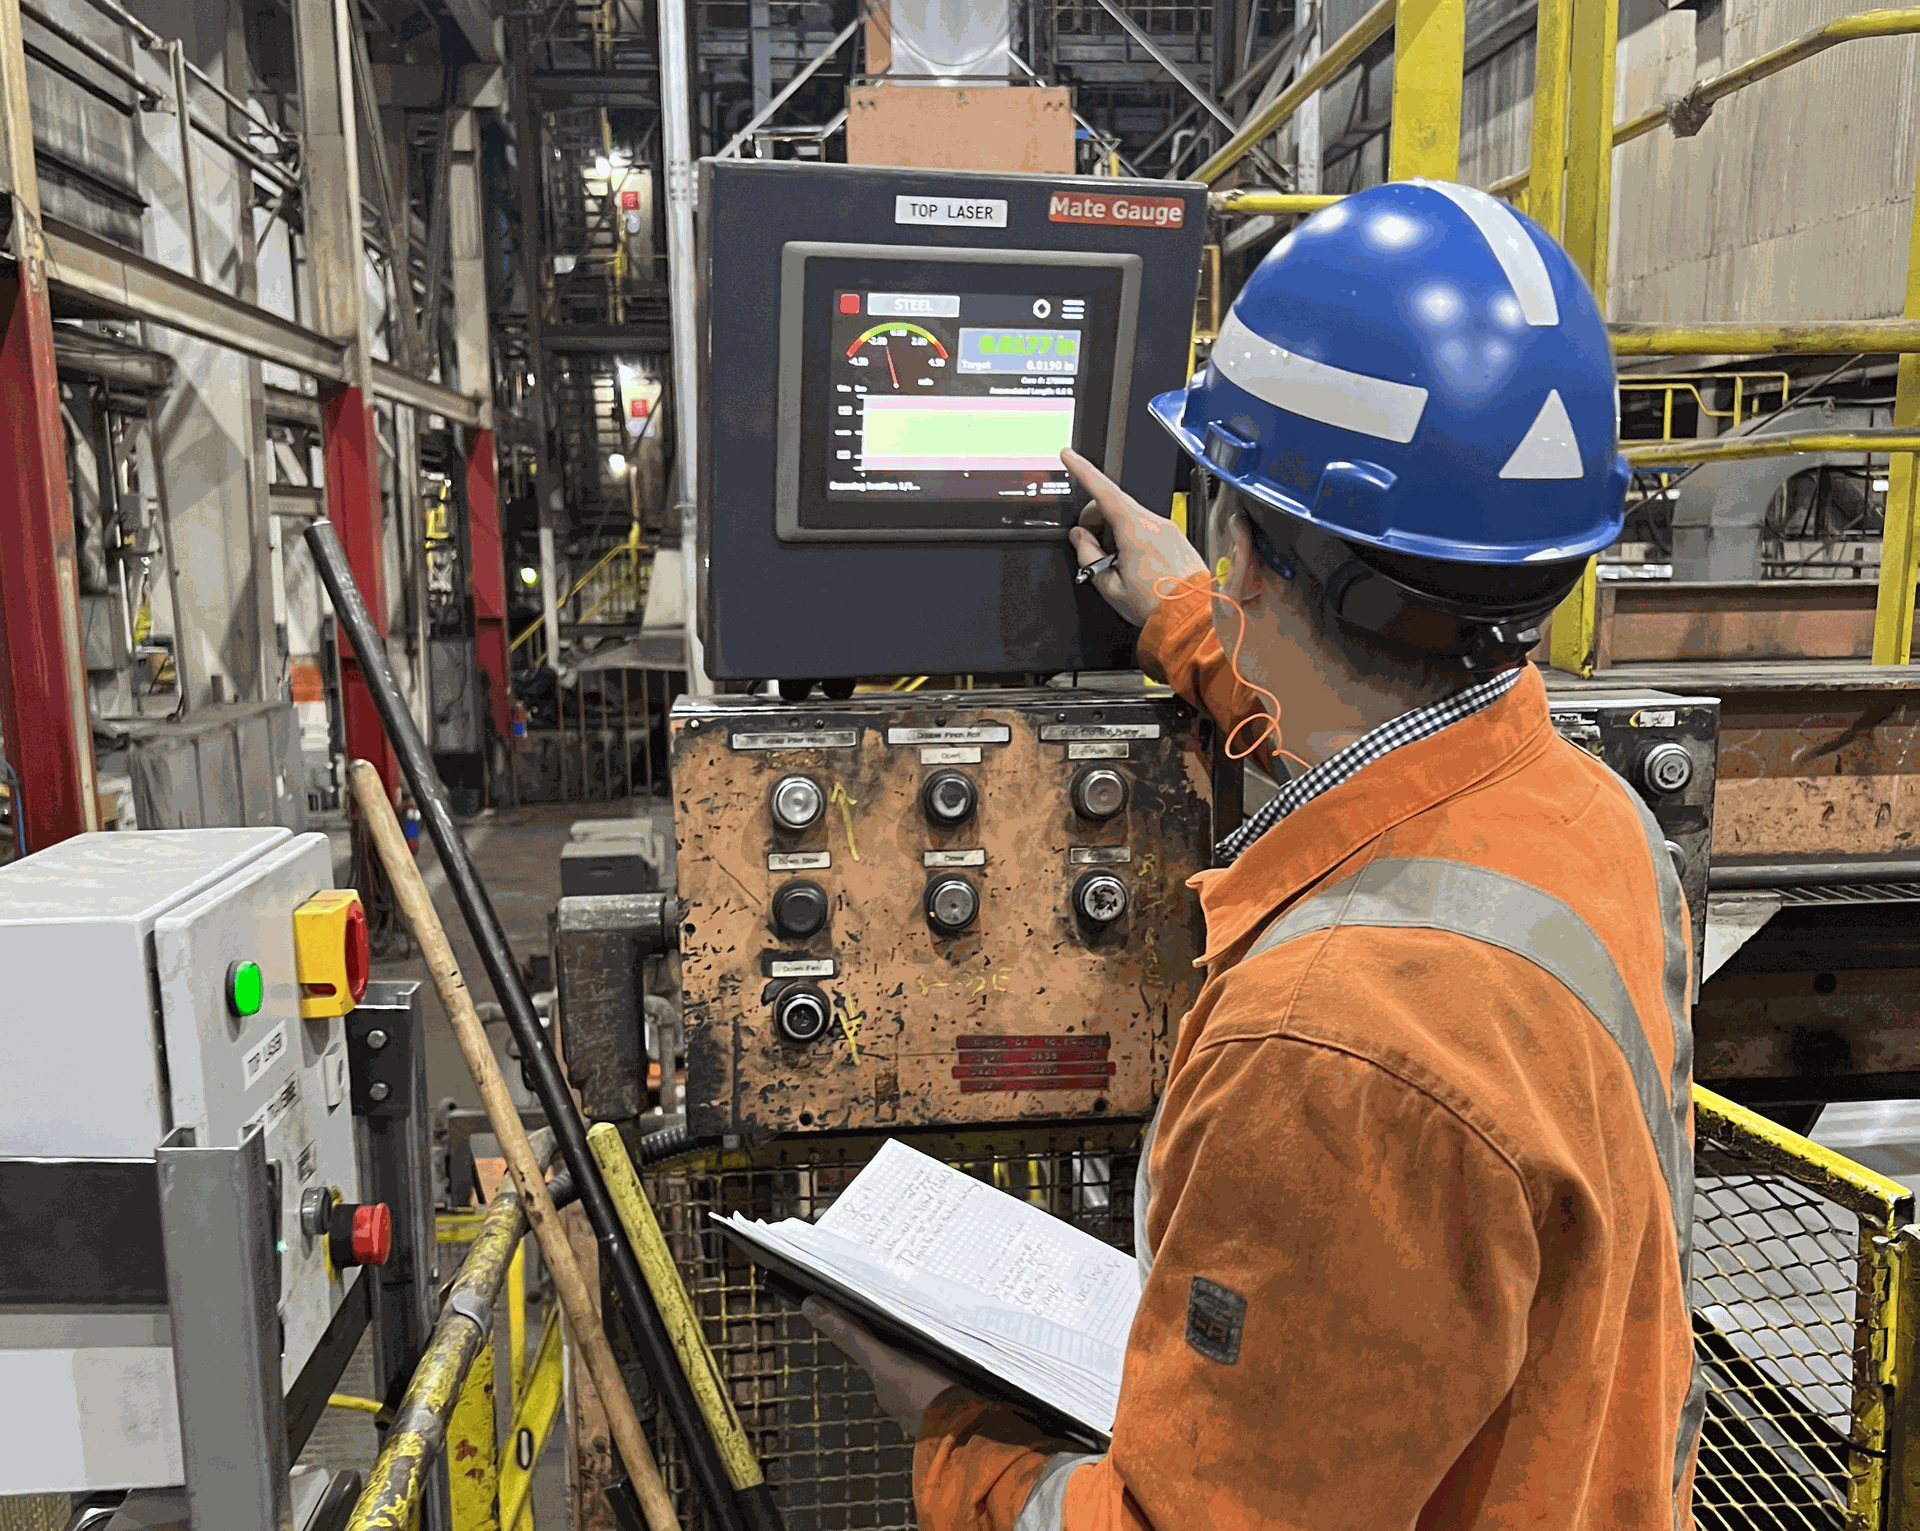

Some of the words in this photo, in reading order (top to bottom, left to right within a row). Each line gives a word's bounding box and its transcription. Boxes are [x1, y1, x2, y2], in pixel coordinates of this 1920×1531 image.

[909, 203, 938, 218] TOP
[947, 204, 994, 220] LASER
[1050, 196, 1106, 218] Mate
[1111, 200, 1182, 226] Gauge
[894, 298, 934, 312] STEEL
[980, 335, 1052, 355] 0.0177
[1056, 335, 1077, 355] in
[961, 360, 992, 371] Target
